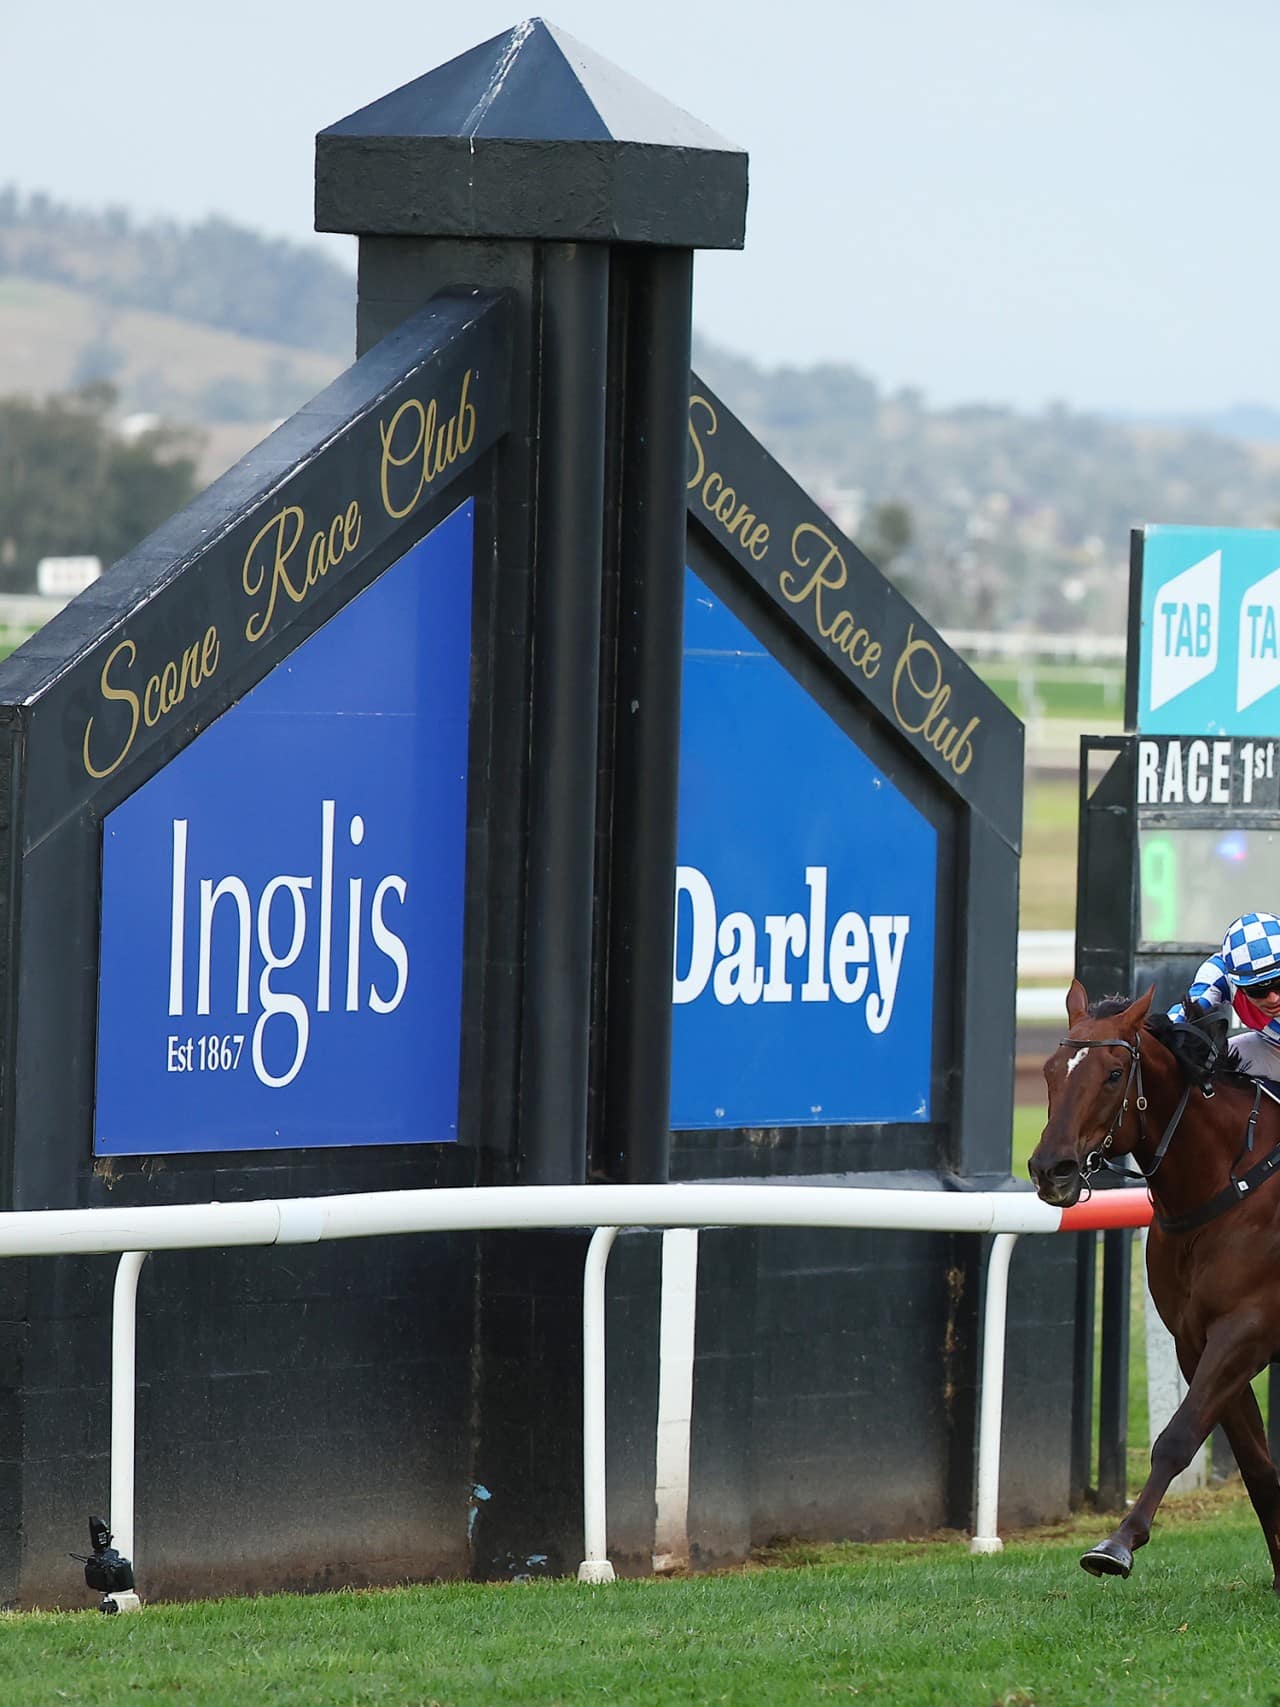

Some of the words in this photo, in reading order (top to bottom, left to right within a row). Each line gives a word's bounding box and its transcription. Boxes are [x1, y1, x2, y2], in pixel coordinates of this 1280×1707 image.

[83, 624, 219, 778] Scone
[243, 500, 362, 642] Race
[380, 368, 476, 518] Club
[687, 395, 769, 561] Scone
[780, 523, 881, 679] Race
[893, 623, 981, 775] Club
[1160, 602, 1212, 658] TAB
[1137, 739, 1232, 804] RACE
[1239, 742, 1275, 804] 1st
[167, 799, 409, 1088] Inglis
[672, 866, 910, 1034] Darley
[167, 1035, 194, 1072] Est
[197, 1034, 245, 1071] 1867
